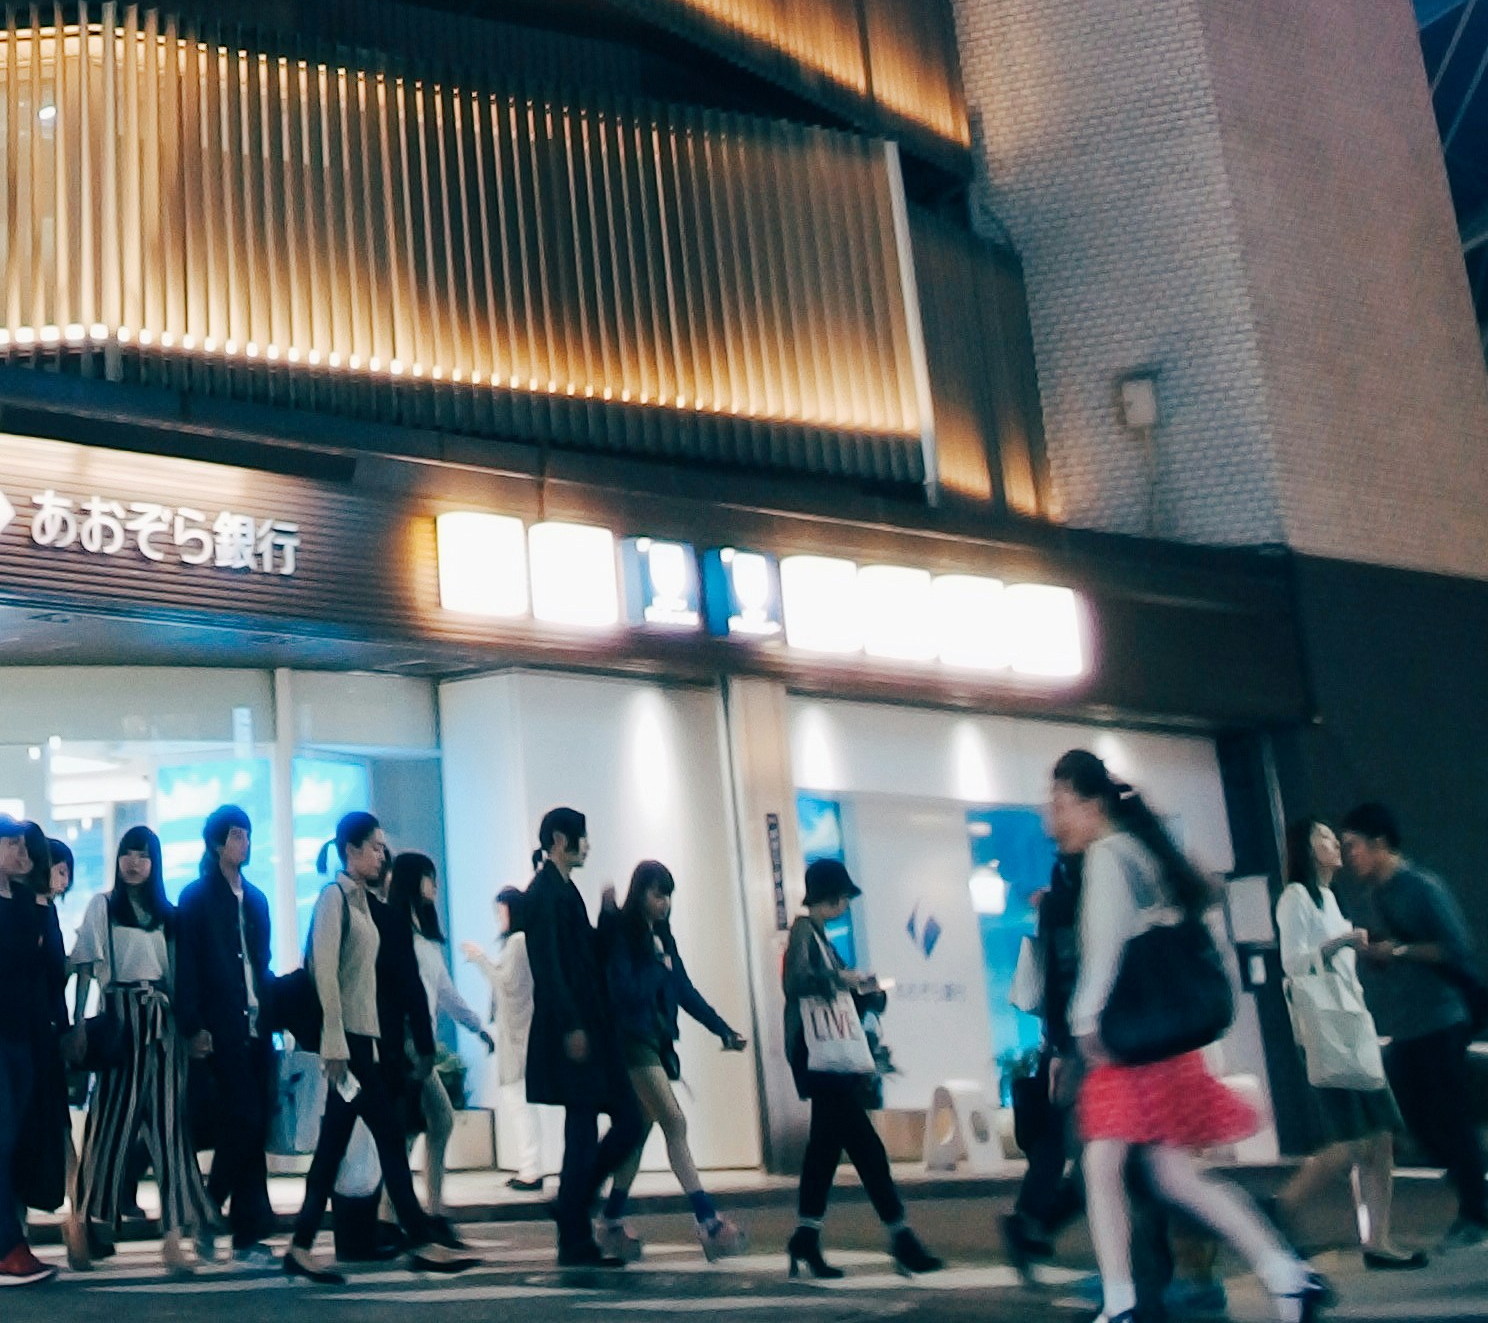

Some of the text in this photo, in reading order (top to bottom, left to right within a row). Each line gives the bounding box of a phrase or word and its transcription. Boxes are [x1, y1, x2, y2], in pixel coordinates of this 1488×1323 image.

[30, 489, 302, 576] あおぞら銀行
